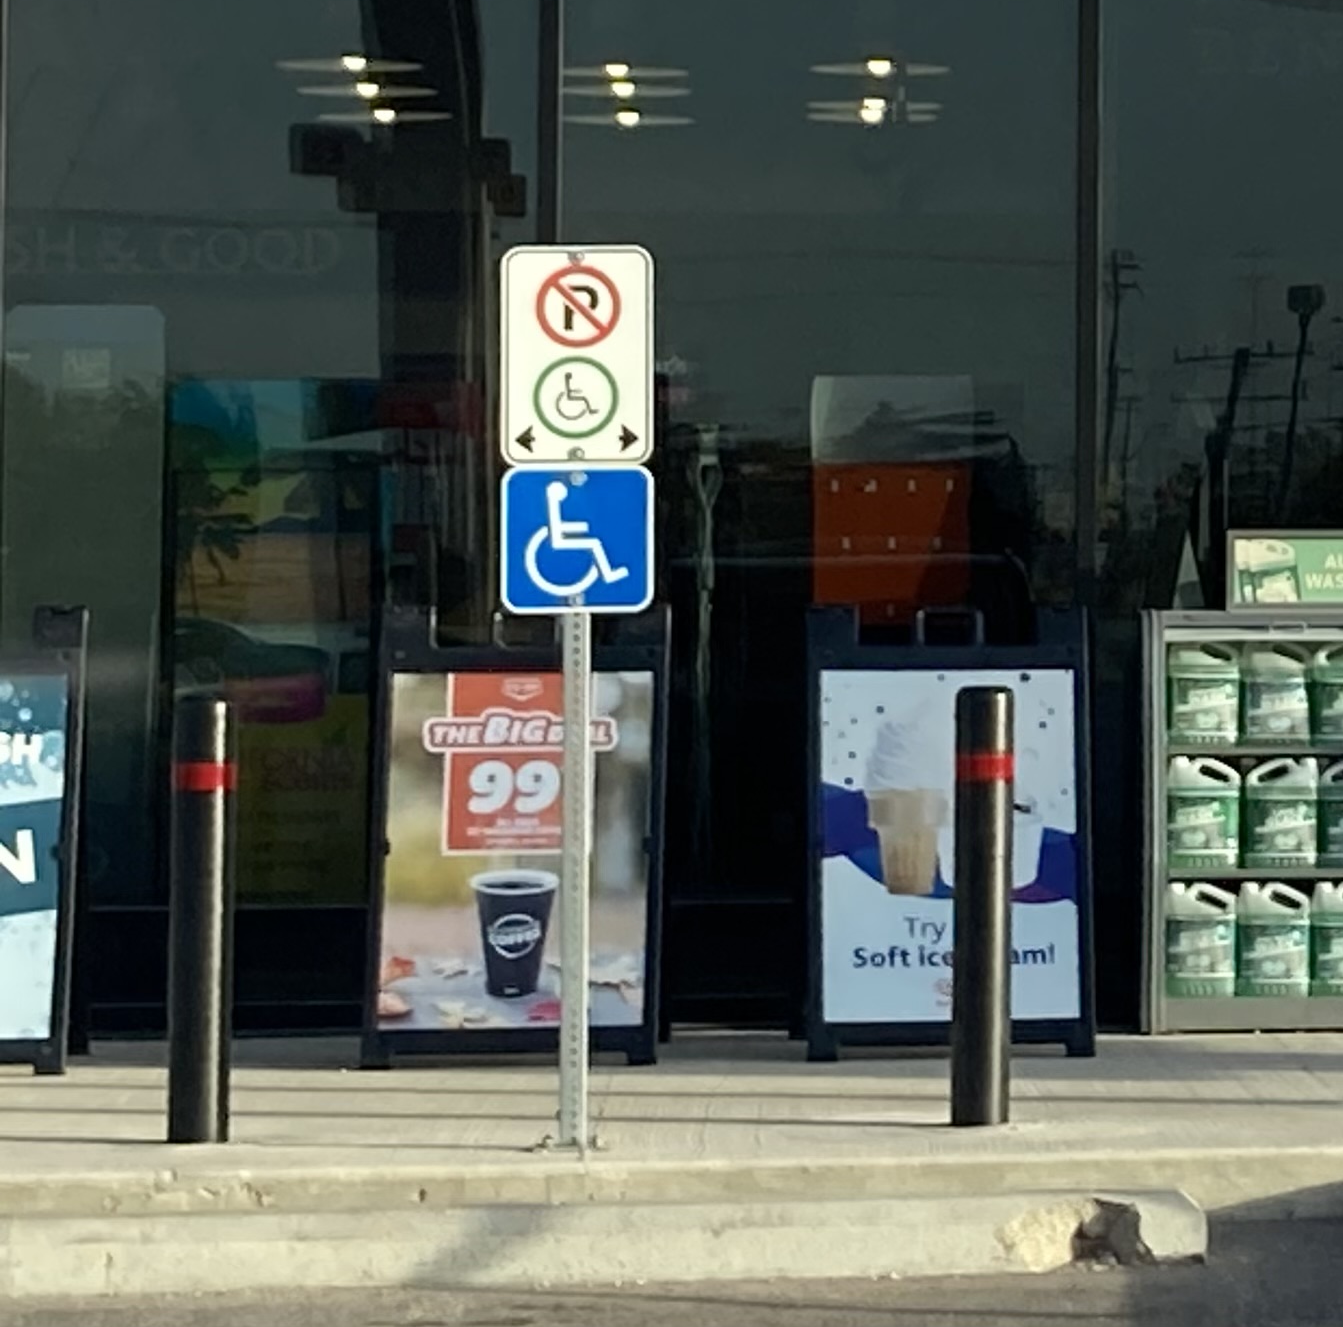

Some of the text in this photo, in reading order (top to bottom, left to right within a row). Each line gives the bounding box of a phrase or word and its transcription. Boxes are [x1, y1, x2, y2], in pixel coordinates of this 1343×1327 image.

[432, 724, 483, 745] THE
[482, 716, 548, 746] BIG
[467, 759, 561, 815] 99
[903, 916, 947, 945] Try
[852, 946, 911, 969] Soft
